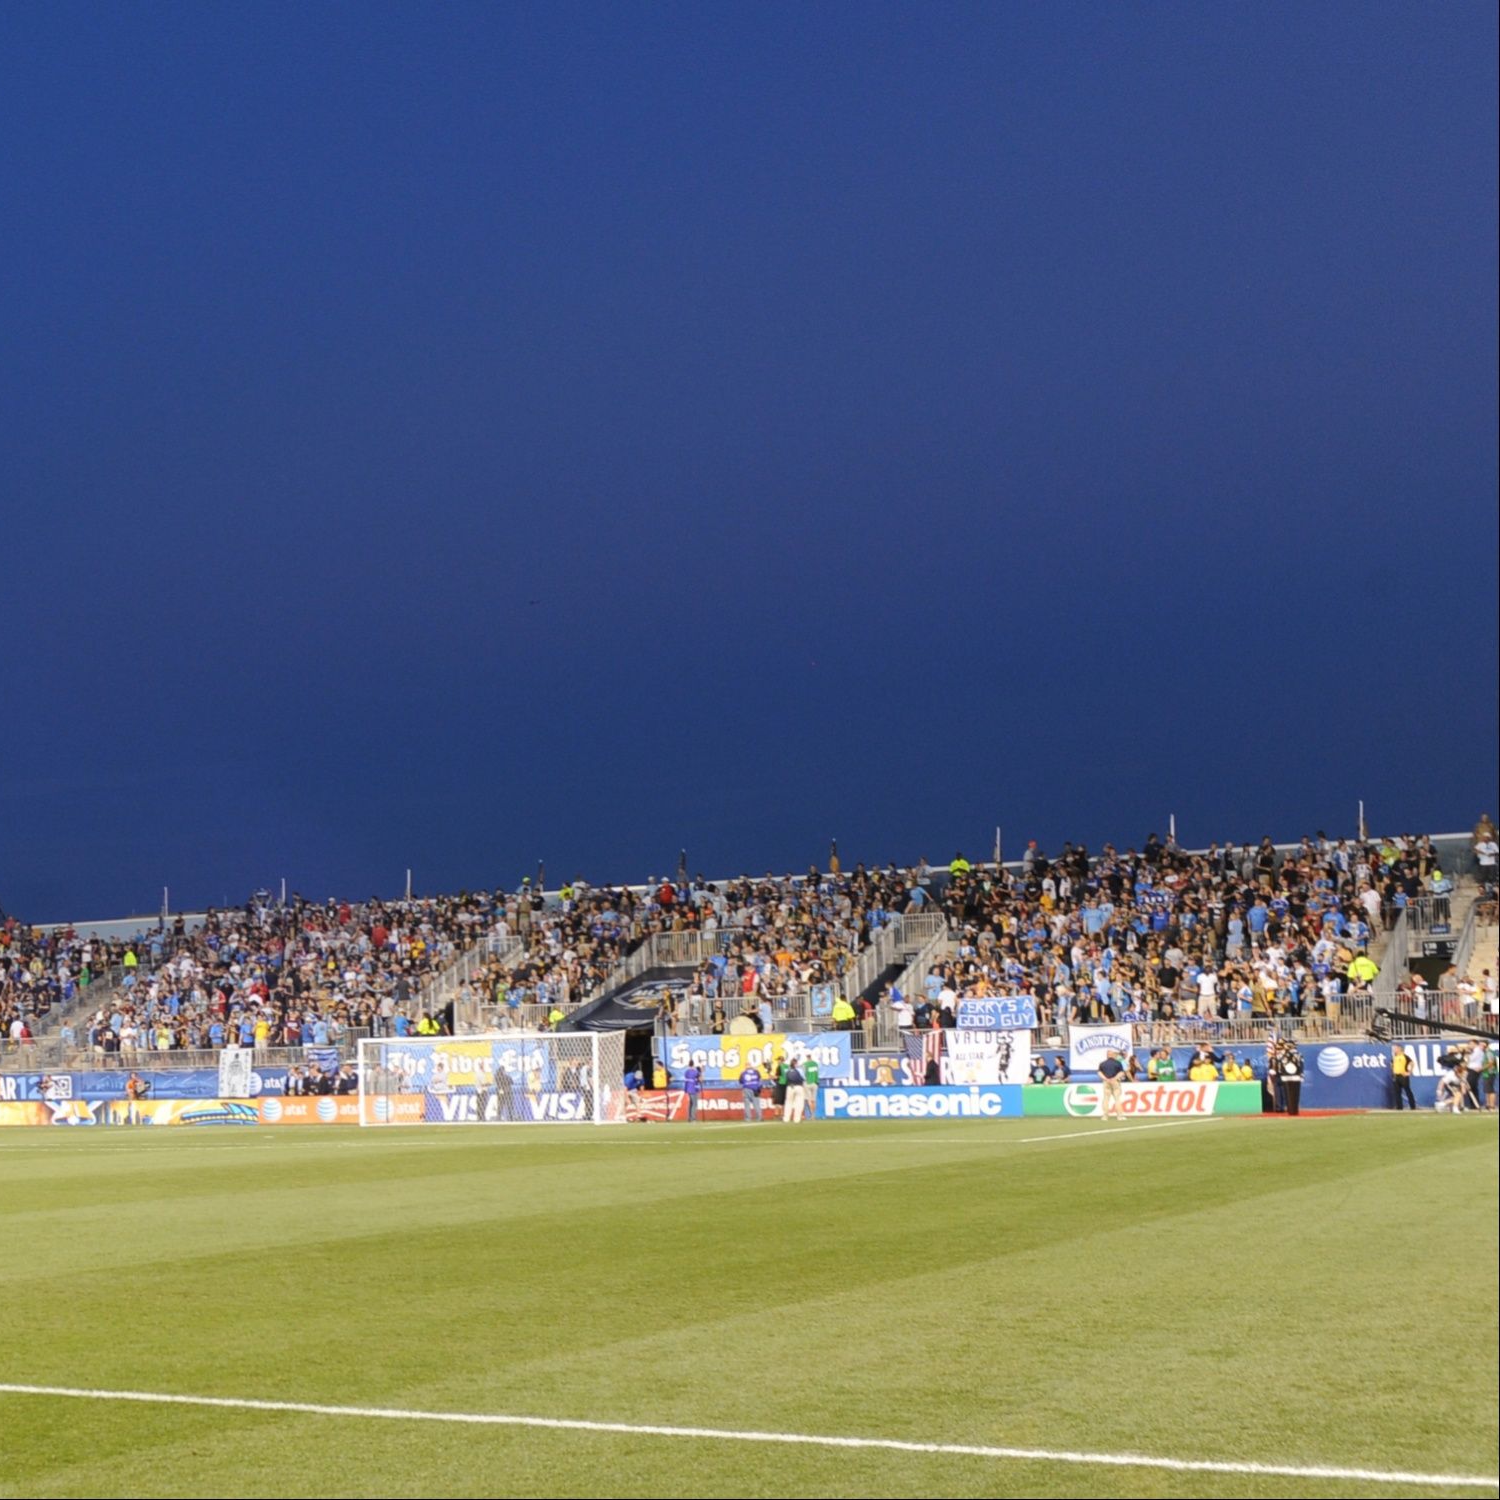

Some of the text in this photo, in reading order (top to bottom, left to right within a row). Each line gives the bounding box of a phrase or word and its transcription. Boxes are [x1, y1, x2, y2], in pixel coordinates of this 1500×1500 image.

[1023, 998, 1034, 1011] A
[959, 1012, 1032, 1028] GOOD GUY
[746, 1041, 773, 1068] of
[1352, 1053, 1387, 1068] at&t
[823, 1086, 1002, 1117] Panasonic
[1107, 1084, 1206, 1114] astrol
